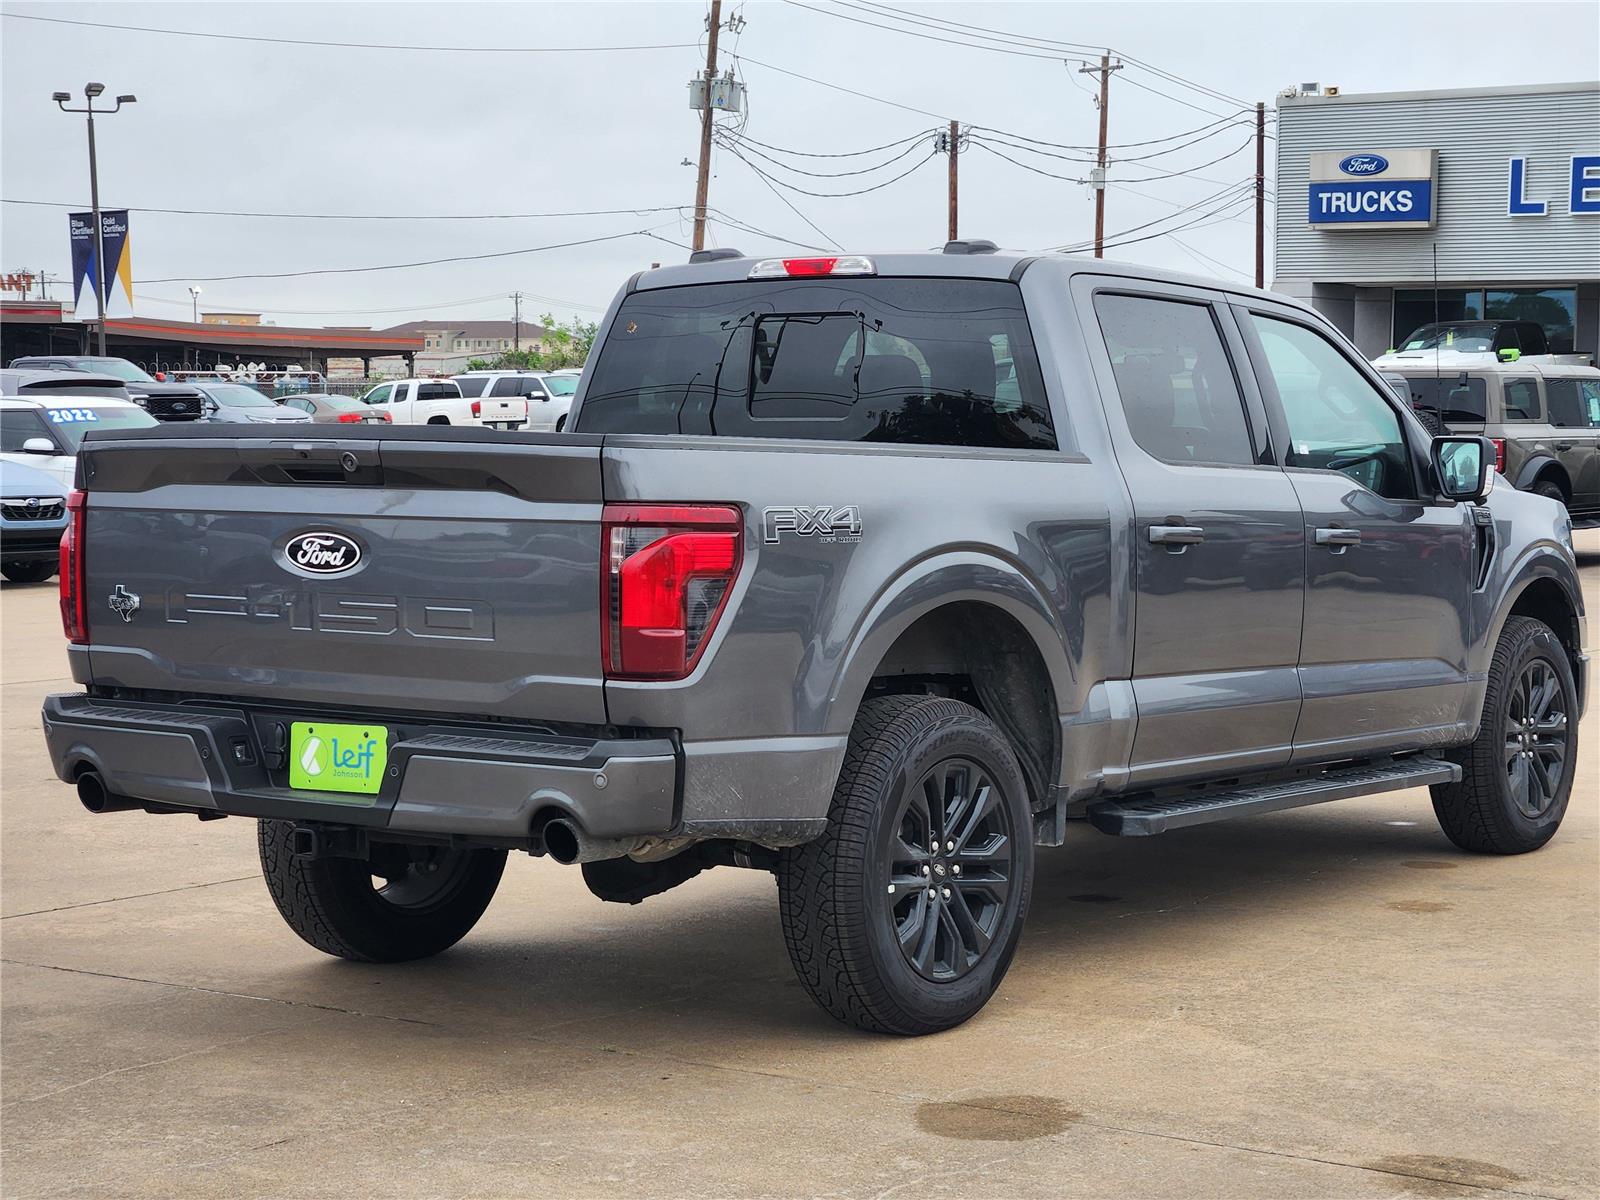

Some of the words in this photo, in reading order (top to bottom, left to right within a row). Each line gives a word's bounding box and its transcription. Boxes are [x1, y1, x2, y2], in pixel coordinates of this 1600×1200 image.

[1318, 190, 1413, 214] TRUCKS
[71, 220, 84, 228] Blue
[103, 217, 116, 225] Gold
[71, 227, 95, 235] Certified
[103, 224, 126, 233] Certified
[48, 409, 97, 423] 2022
[762, 505, 863, 545] FX4
[297, 537, 347, 566] Ford
[333, 769, 363, 779] Johnson
